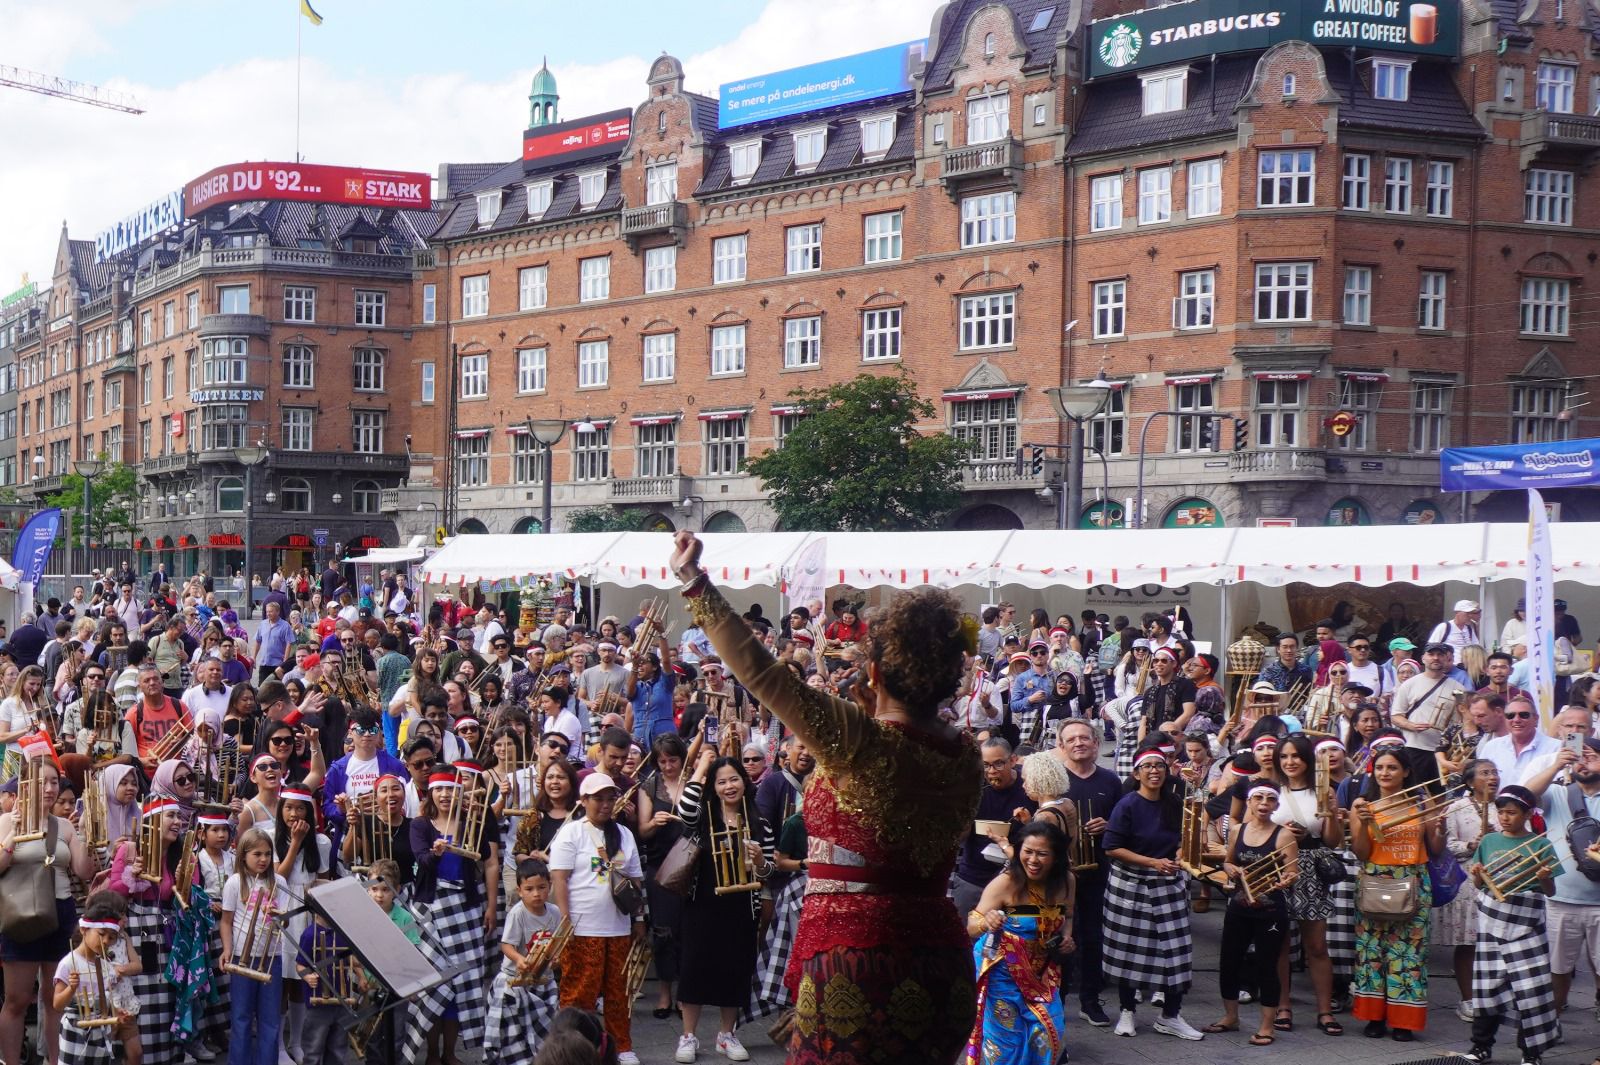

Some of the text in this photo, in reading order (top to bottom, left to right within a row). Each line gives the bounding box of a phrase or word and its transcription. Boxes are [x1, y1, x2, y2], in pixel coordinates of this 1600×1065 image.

[1324, 0, 1400, 18] A WORLD OF
[1150, 11, 1281, 46] STARBUCKS
[1313, 20, 1407, 44] GREAT COFFEE!
[728, 82, 746, 94] andel
[728, 73, 856, 110] Se mere på andelenergi.dk
[192, 179, 229, 206] HUSKER
[233, 170, 262, 191] DU
[366, 180, 422, 199] STARK
[94, 187, 184, 265] POLITIKEN
